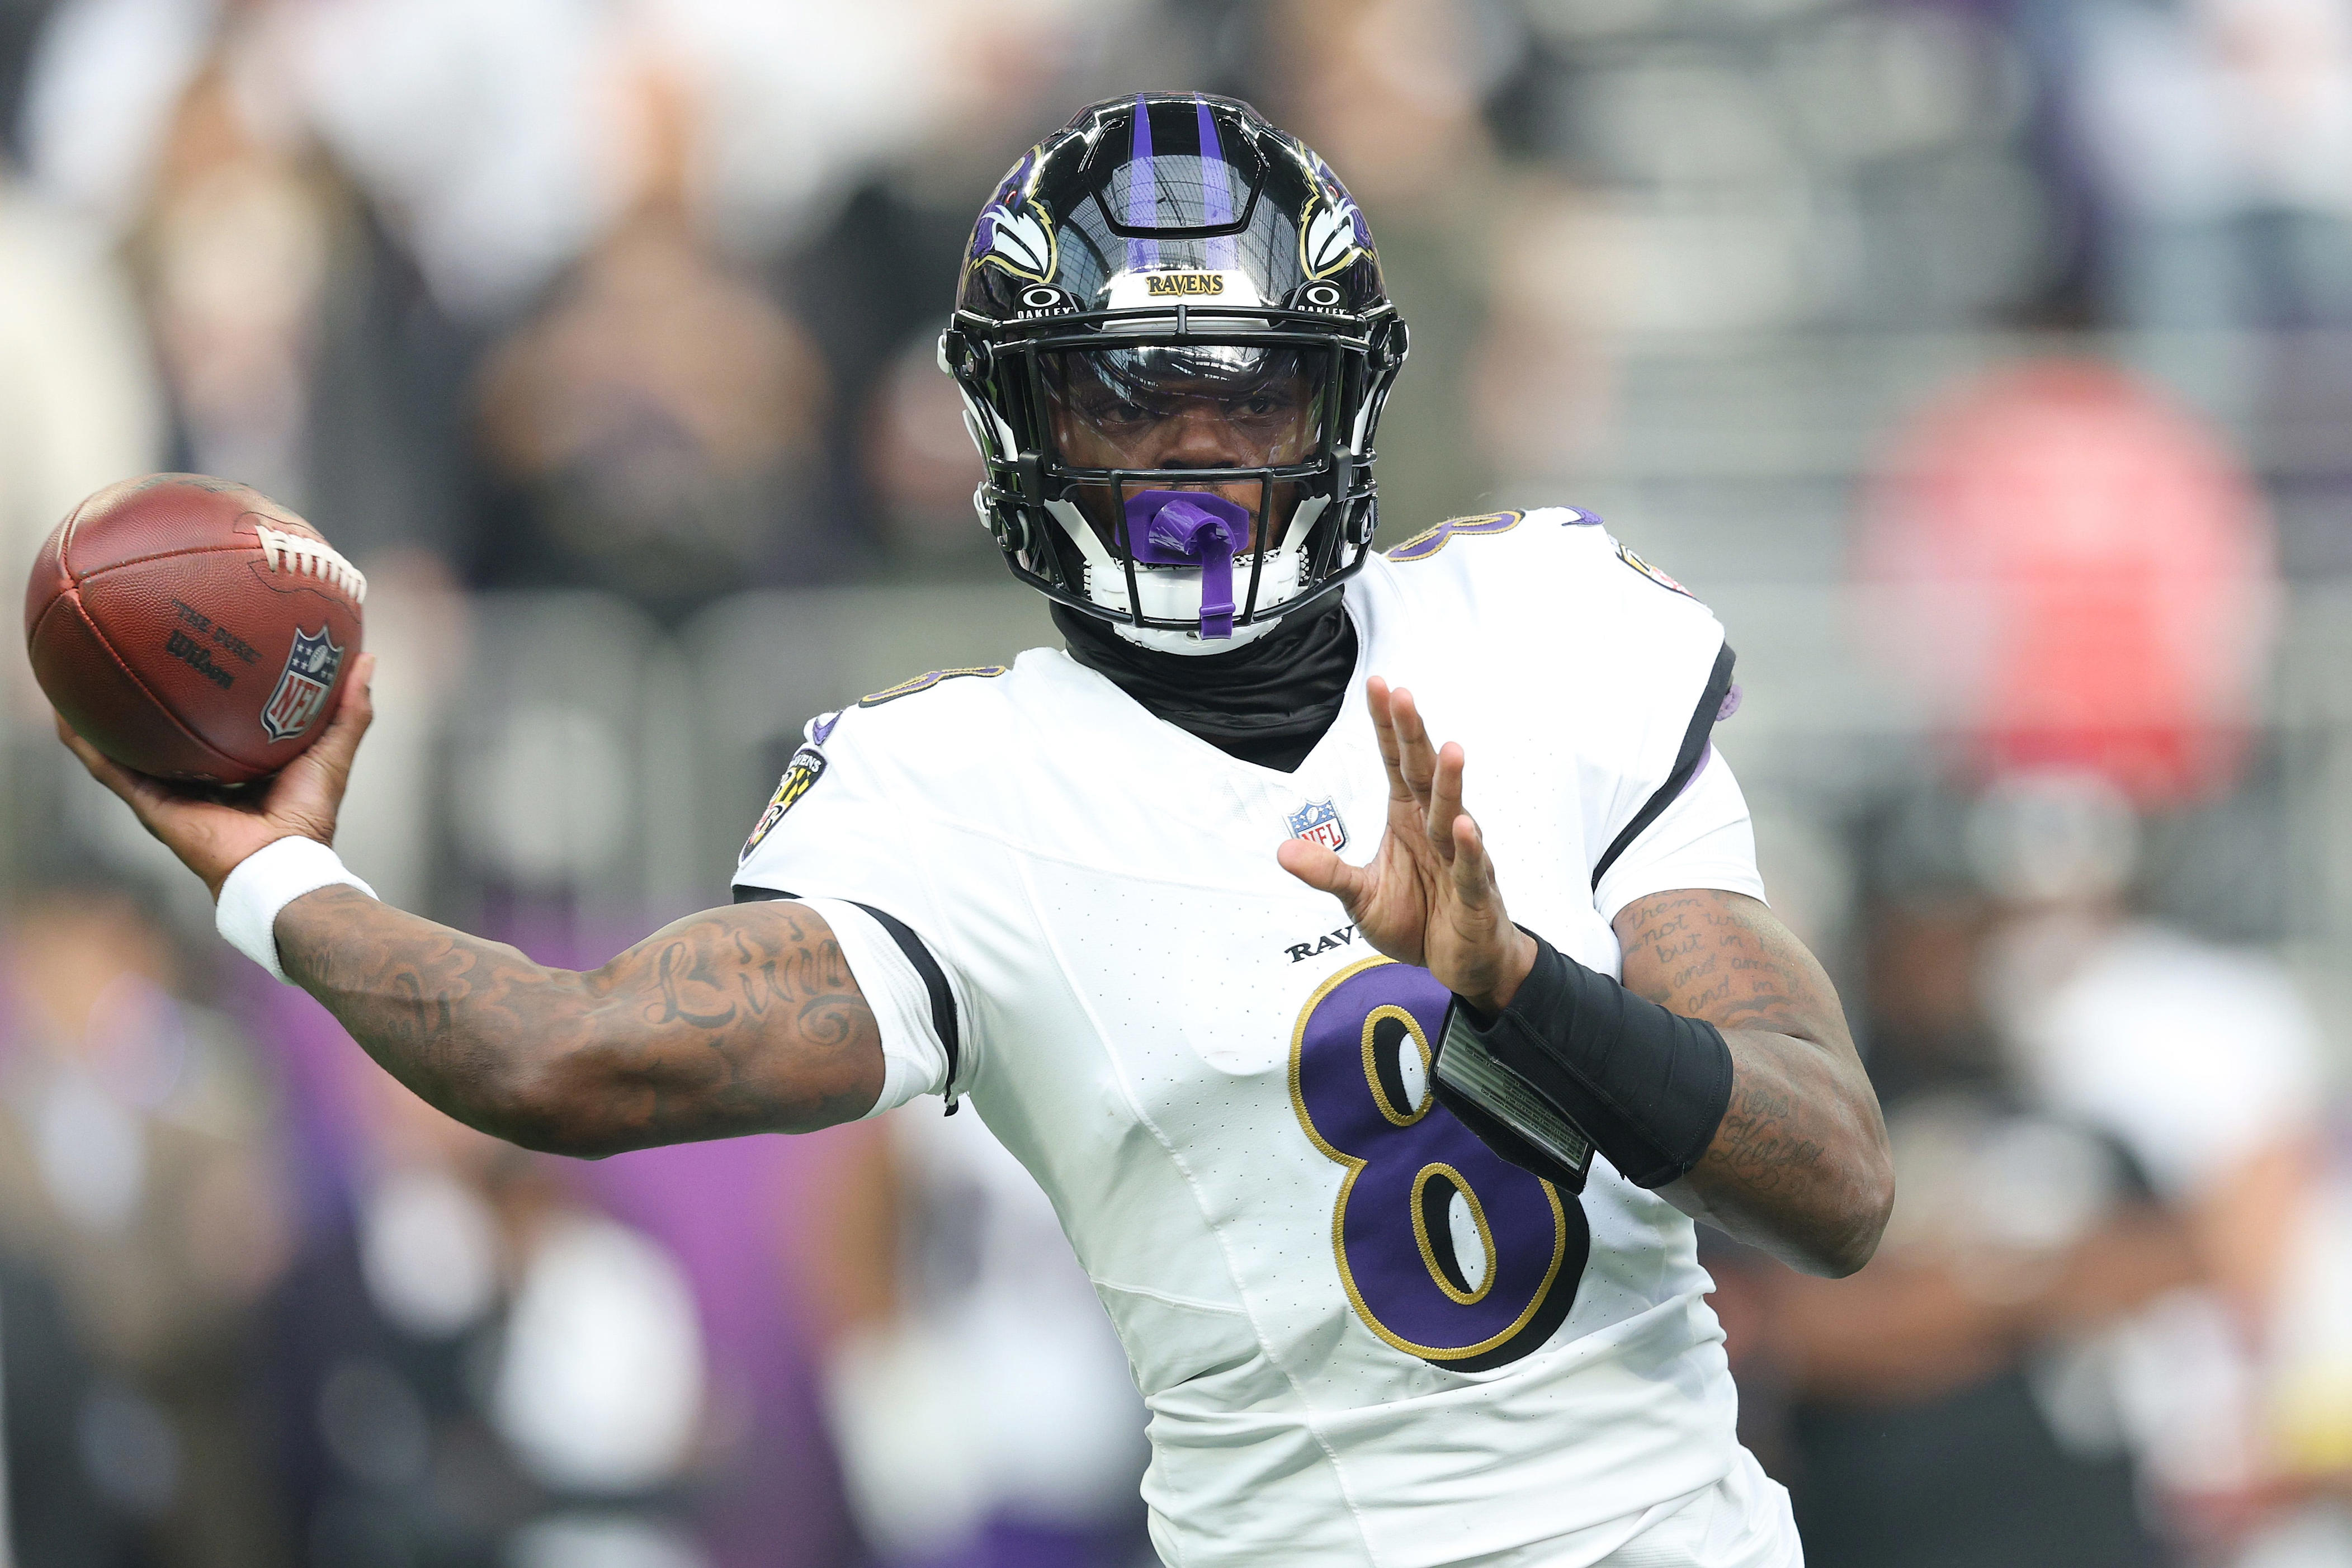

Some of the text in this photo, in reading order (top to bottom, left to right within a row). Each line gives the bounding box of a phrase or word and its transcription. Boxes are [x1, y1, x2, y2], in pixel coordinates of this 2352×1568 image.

[1146, 275, 1224, 297] RAVENS
[1017, 306, 1073, 319] OAKLEY
[270, 675, 322, 728] NFL
[1284, 924, 1362, 963] RAV
[1643, 914, 1689, 946] not
[1656, 934, 1705, 963] but
[1674, 953, 1716, 987] and
[1689, 975, 1731, 1014] and
[1288, 954, 1589, 1373] 8
